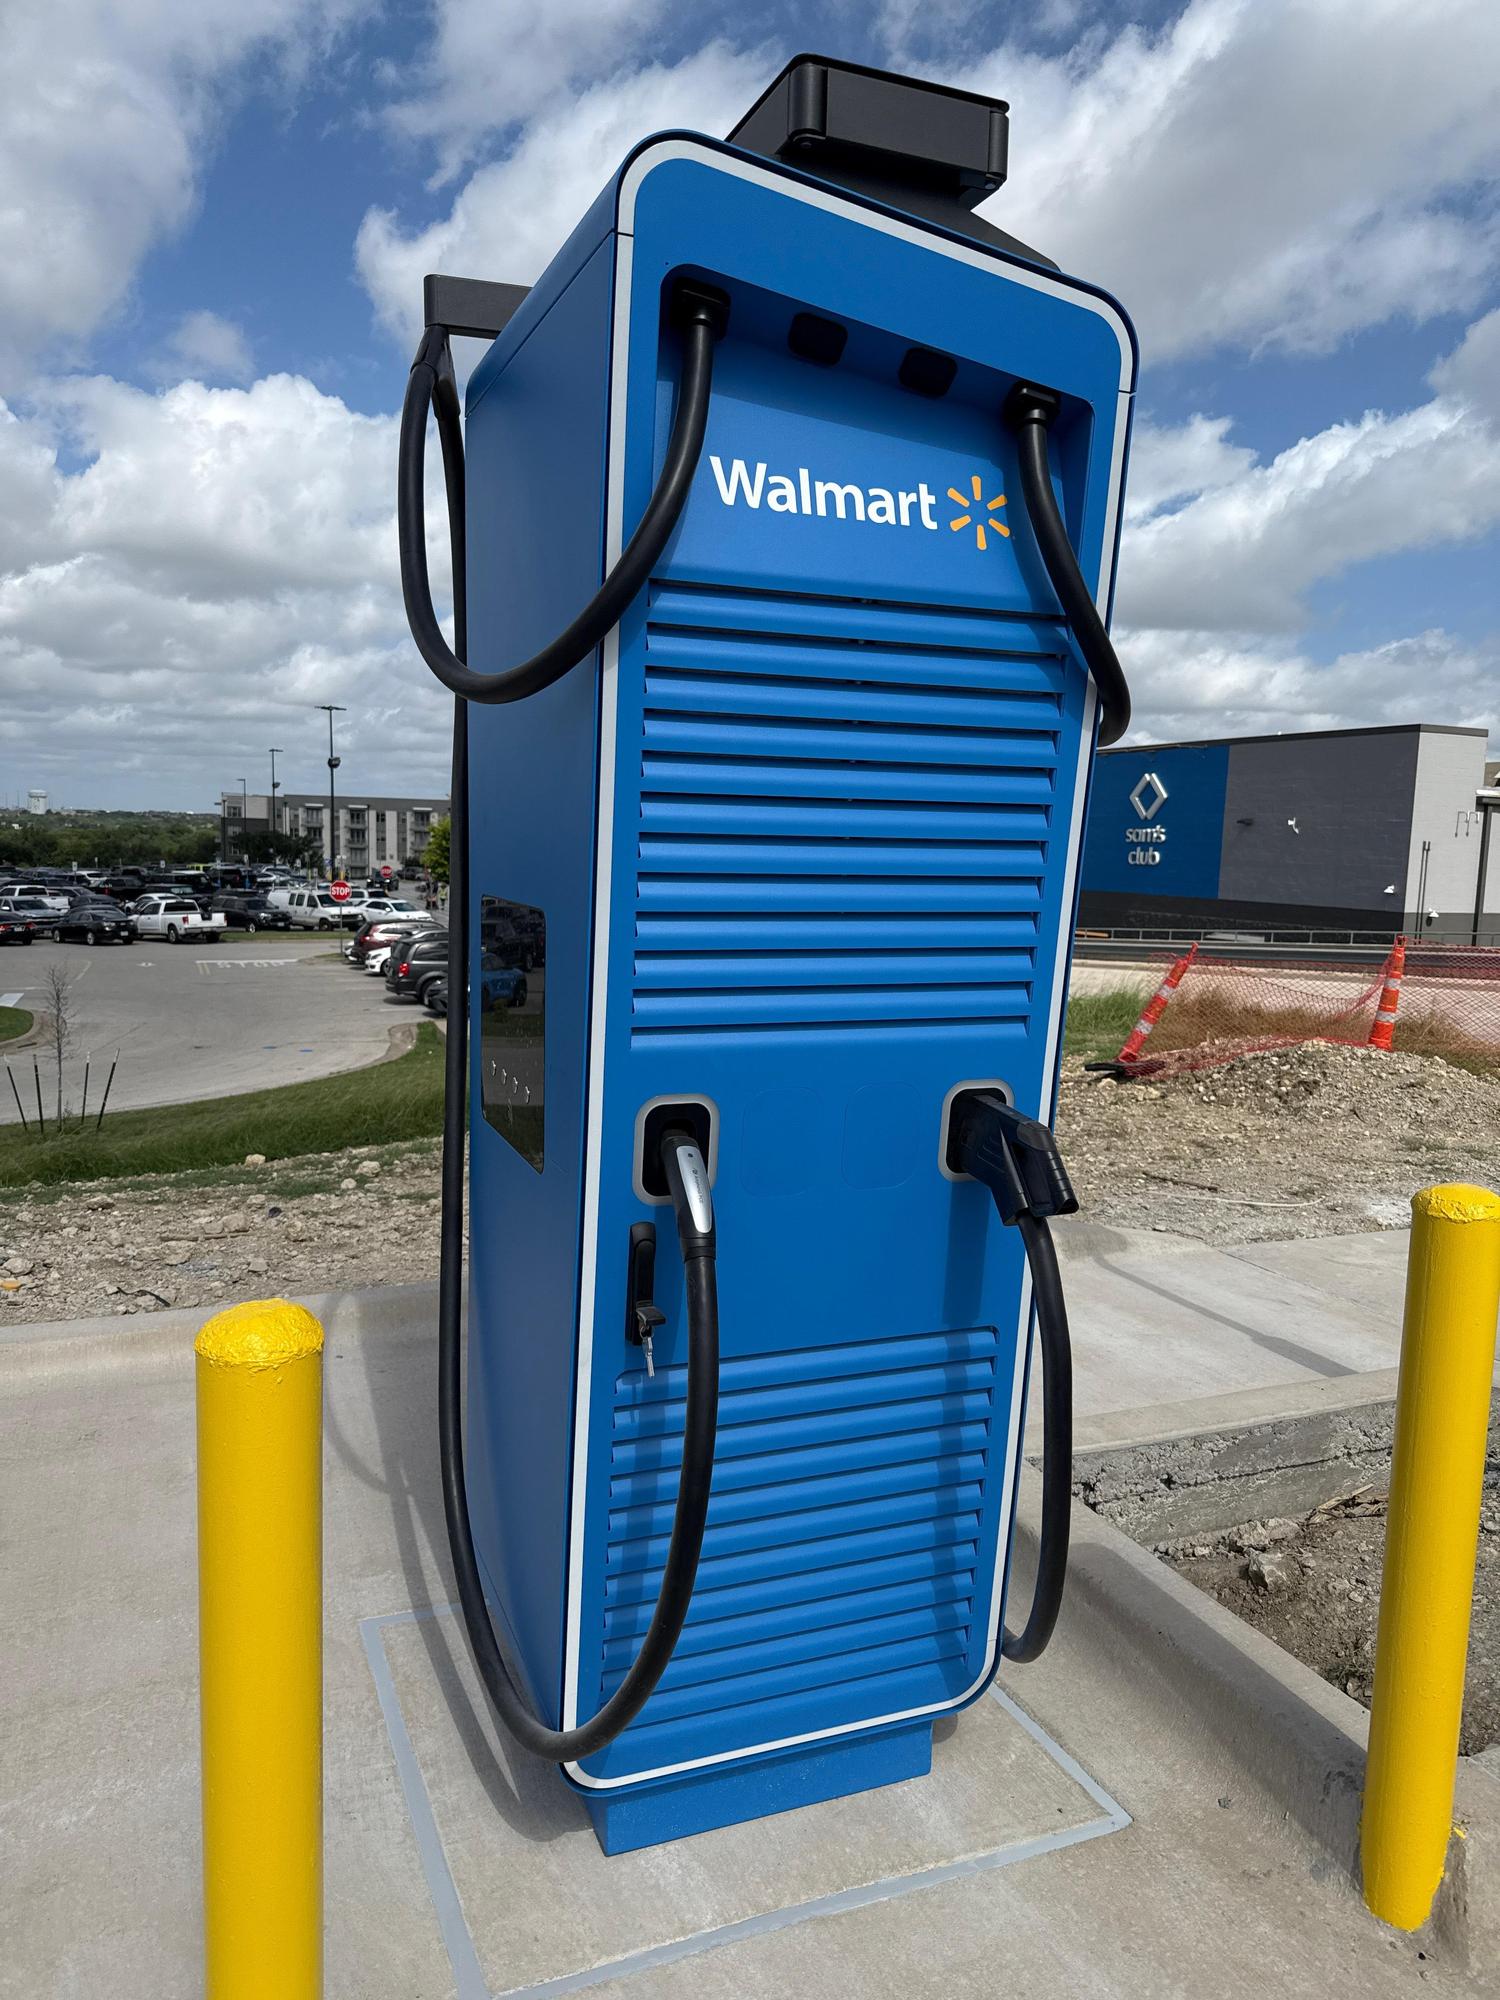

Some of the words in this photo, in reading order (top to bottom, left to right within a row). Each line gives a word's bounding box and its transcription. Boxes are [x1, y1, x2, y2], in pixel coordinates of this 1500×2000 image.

[709, 455, 938, 530] Walmart
[1125, 825, 1166, 842] sam's
[1128, 846, 1160, 865] club
[331, 886, 350, 896] STOP
